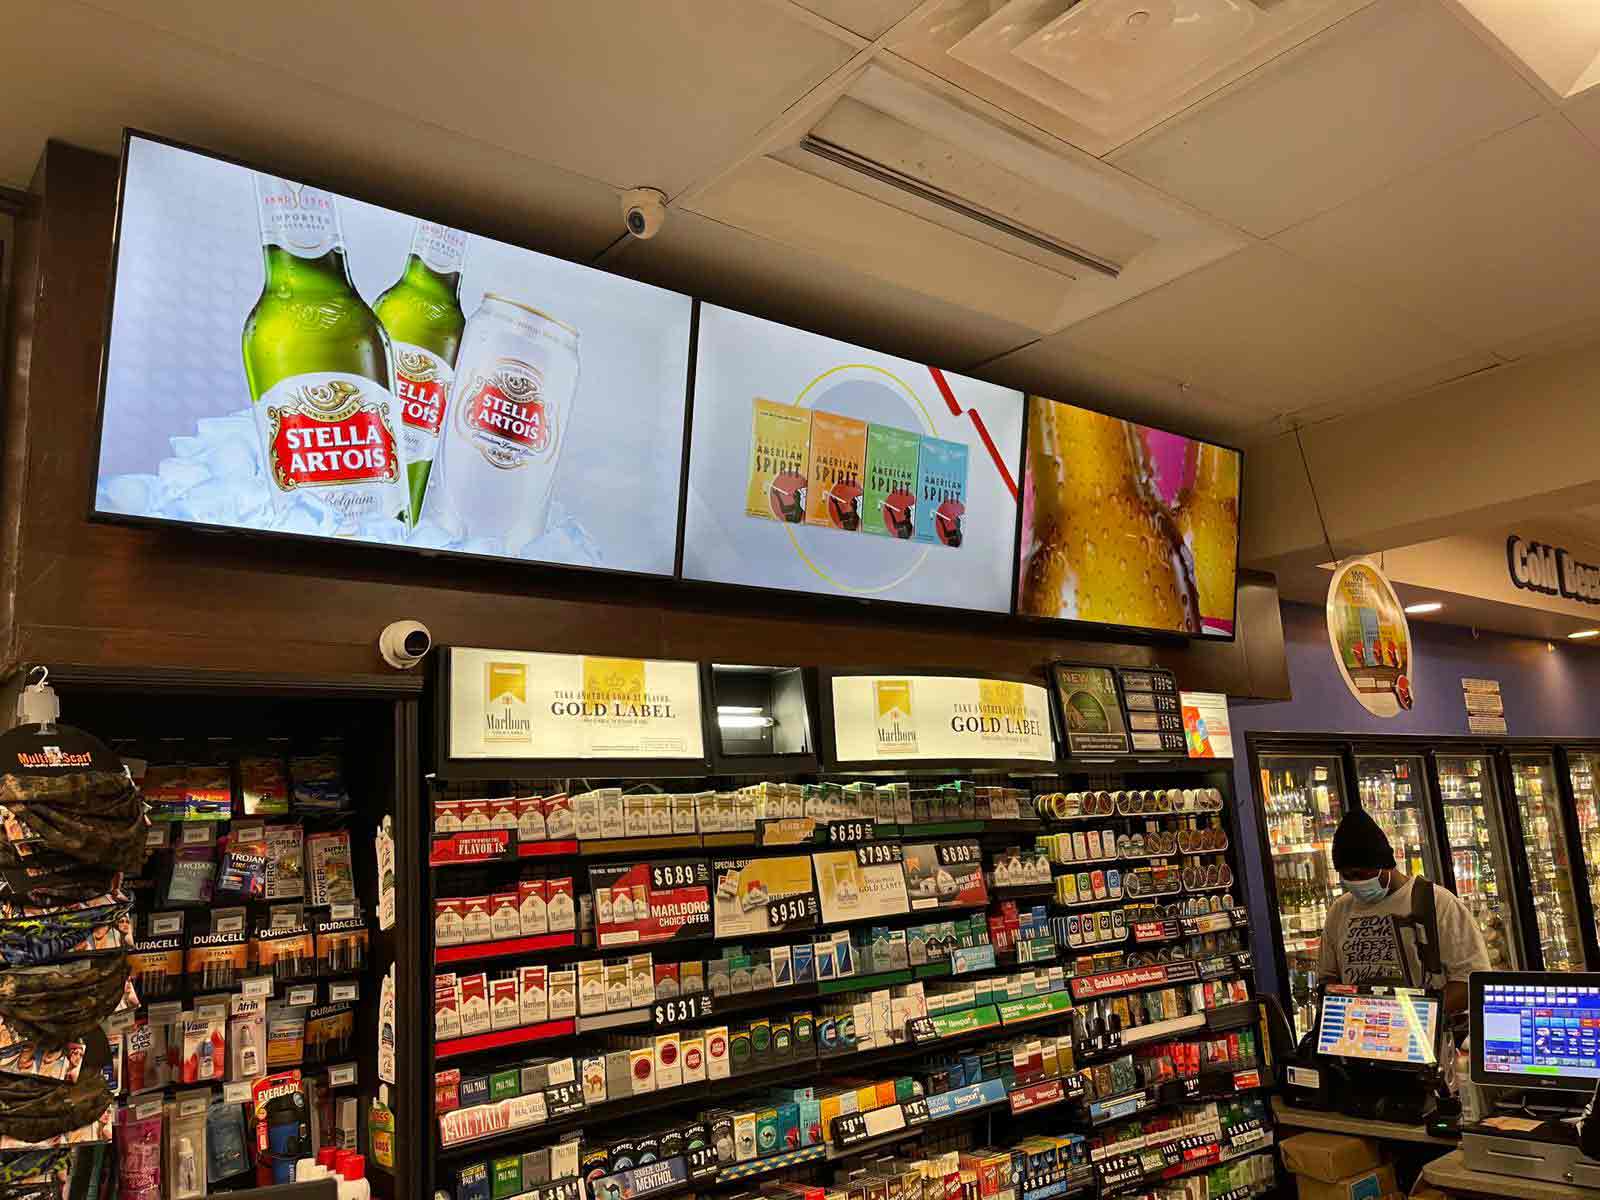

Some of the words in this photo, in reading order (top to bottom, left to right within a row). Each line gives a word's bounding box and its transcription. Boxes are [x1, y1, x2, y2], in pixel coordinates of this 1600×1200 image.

[397, 381, 440, 408] ELLA
[400, 399, 438, 423] TOIS
[482, 394, 540, 424] STELLA
[479, 409, 538, 439] ARTOIS
[285, 424, 383, 449] STELLA
[290, 448, 386, 473] ARTOIS
[757, 445, 802, 460] AMERICAN
[757, 456, 801, 477] SPIRIT
[816, 456, 859, 471] AMERICAN
[816, 466, 858, 487] SPIRIT
[872, 466, 912, 480] AMERICAN
[925, 475, 962, 489] AMERICAN
[871, 475, 911, 494] SPIRIT
[924, 486, 961, 503] SPIRIT
[1507, 535, 1558, 596] Cold
[1556, 547, 1600, 605] Bee
[551, 701, 607, 717] GOLD
[614, 703, 677, 719] LABEL
[486, 708, 530, 731] Marlboro
[951, 716, 1001, 733] GOLD
[1006, 718, 1042, 737] LABEL
[878, 722, 917, 743] Marlboro
[62, 752, 92, 763] Scarf
[830, 823, 862, 842] $6.59
[458, 843, 492, 855] FLAVOR
[859, 845, 890, 865] $7.99
[942, 846, 970, 863] $6.89
[231, 853, 265, 865] TROJAN
[654, 864, 694, 887] $6.89
[651, 901, 709, 918] MARLBORO
[770, 899, 806, 924] $9.50
[319, 918, 365, 932] DURACELL
[659, 917, 686, 928] CHOICE
[687, 914, 709, 925] OFFER
[193, 932, 245, 946] DURACELL
[237, 1001, 259, 1012] Afrin
[655, 998, 696, 1024] $6.31
[131, 1032, 153, 1044] Clear
[258, 1082, 300, 1101] EVEREADY
[444, 1111, 473, 1141] PALL
[473, 1109, 507, 1134] MALL
[685, 1126, 705, 1138] CAMEL
[712, 1119, 731, 1131] CAMEL
[637, 1139, 658, 1151] CAMEL
[661, 1132, 682, 1144] CAMEL
[612, 1143, 634, 1155] CAMEL
